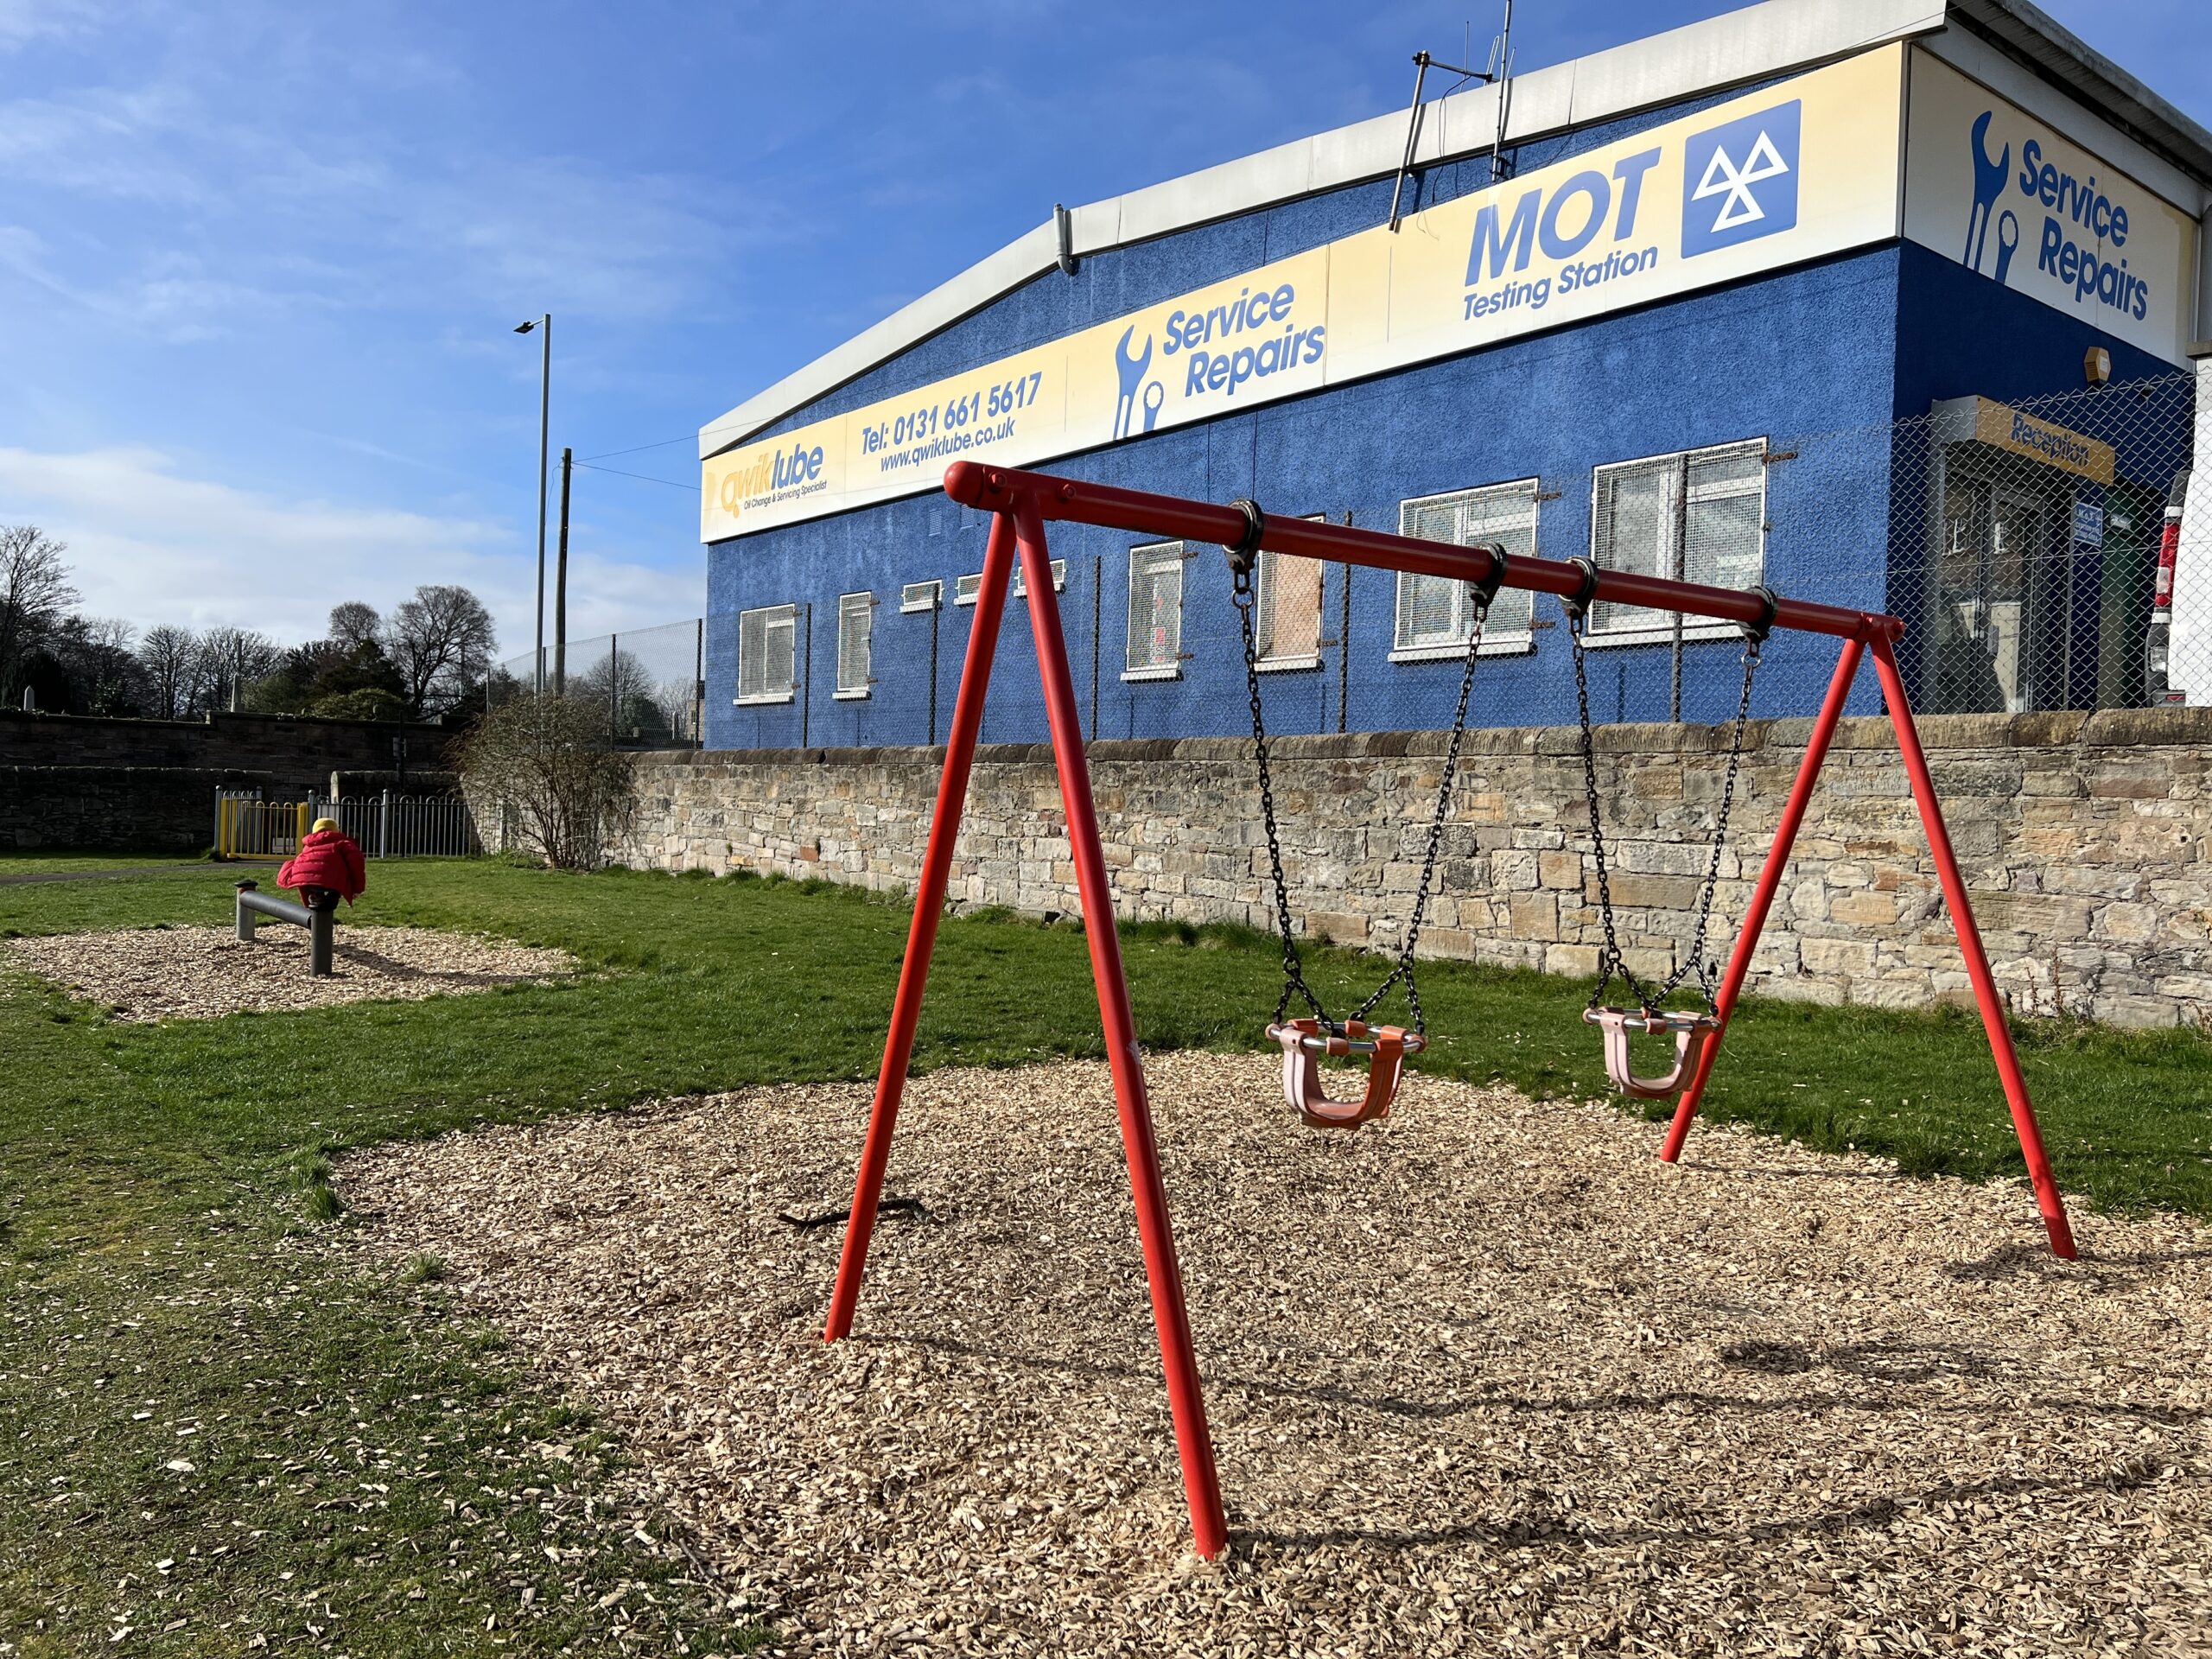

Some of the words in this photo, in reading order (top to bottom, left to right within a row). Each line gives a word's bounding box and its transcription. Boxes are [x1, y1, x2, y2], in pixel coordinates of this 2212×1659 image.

[1465, 146, 1662, 287] MOT
[2019, 139, 2128, 247] Service
[1464, 276, 1552, 321] Testing
[1558, 245, 1658, 295] Station
[2038, 216, 2148, 321] Repairs
[1163, 283, 1294, 355] Service
[1185, 323, 1325, 397] Repairs
[862, 423, 889, 454] Tel:
[893, 405, 939, 445] 0131
[944, 391, 981, 430] 661
[987, 372, 1042, 417] 5617
[880, 416, 1015, 472] www.qwiklube.co.uk
[2012, 414, 2089, 467] Reception
[752, 497, 771, 507] Change
[772, 493, 777, 502] &
[777, 488, 800, 501] Servicing
[801, 480, 828, 496] Specialist
